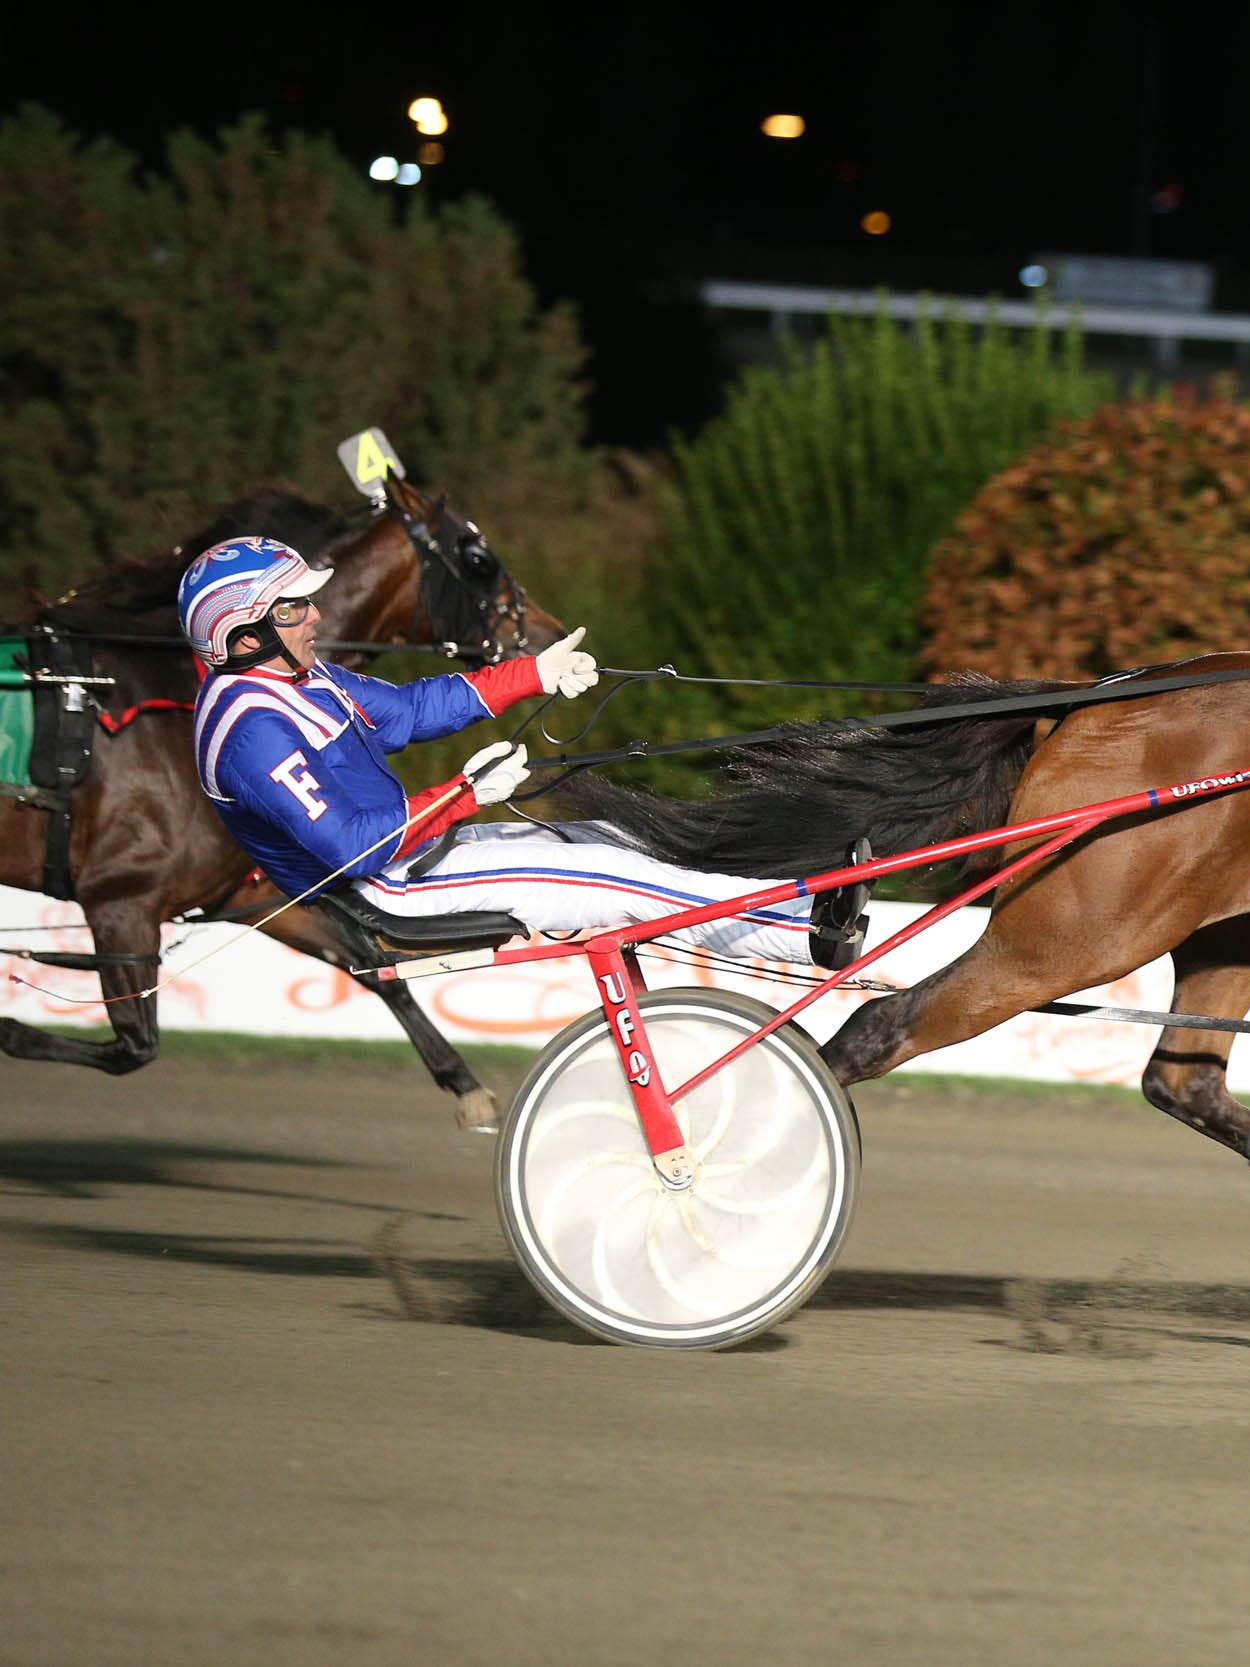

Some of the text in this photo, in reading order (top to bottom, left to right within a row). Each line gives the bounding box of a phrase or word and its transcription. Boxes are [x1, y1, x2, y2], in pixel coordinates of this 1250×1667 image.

[356, 431, 397, 485] 4
[268, 748, 329, 823] F
[600, 970, 652, 1087] UFO
